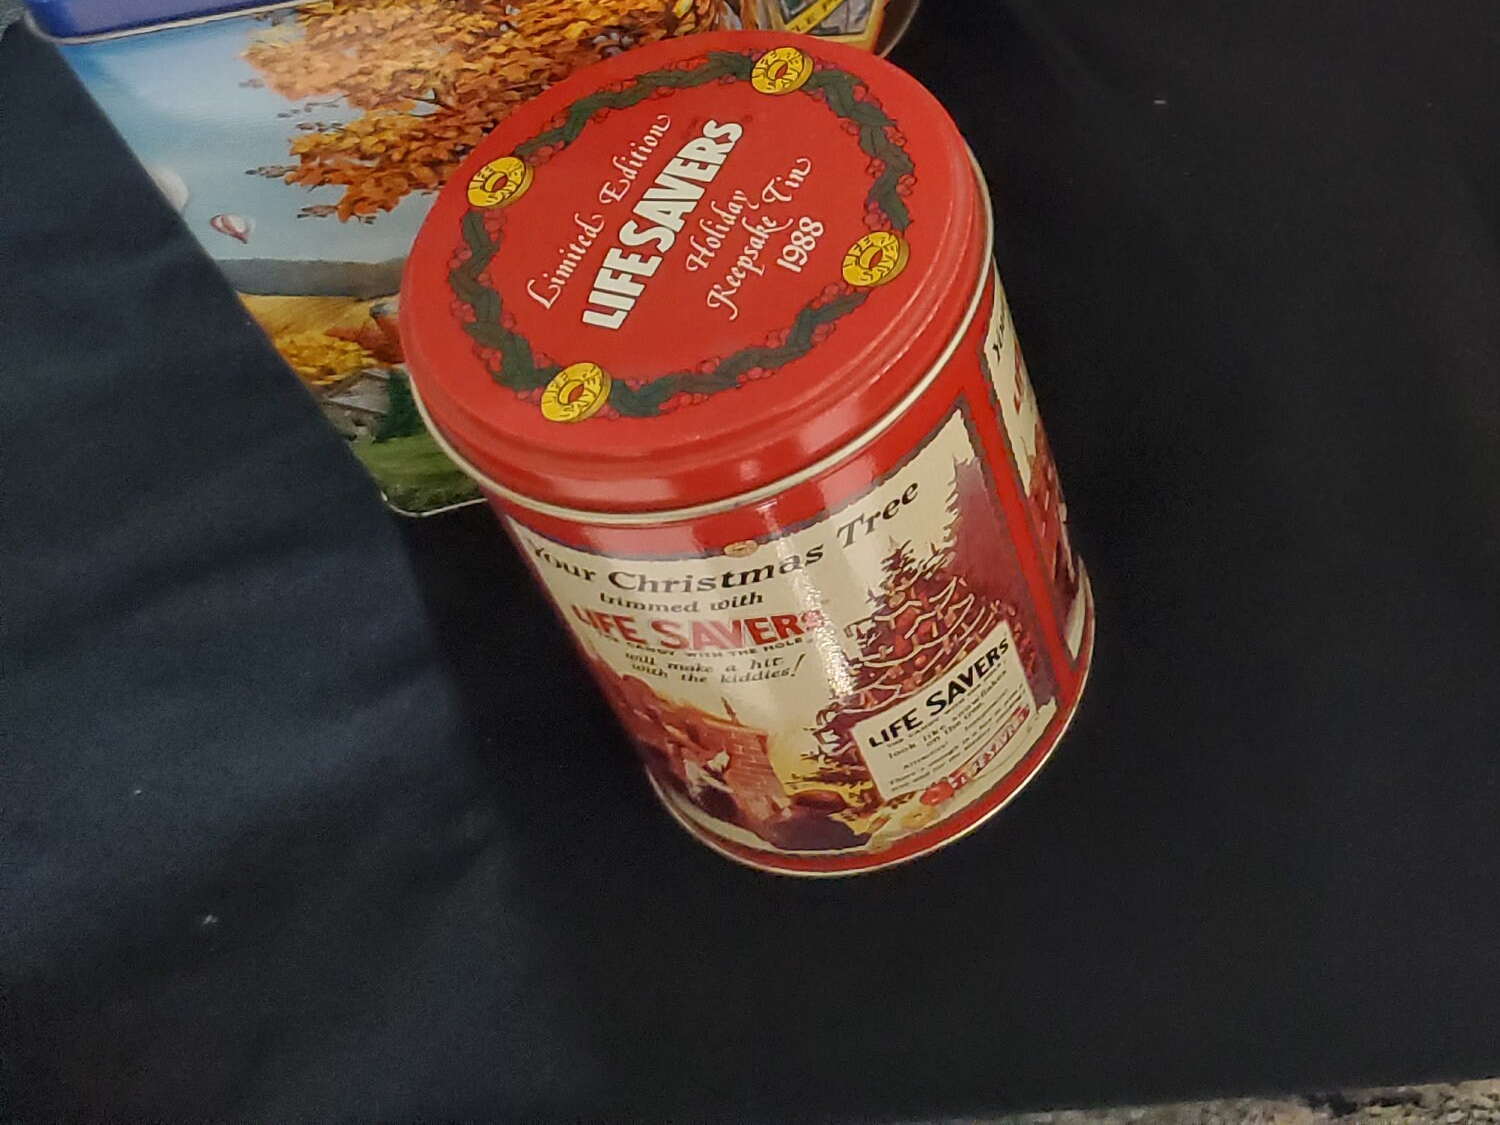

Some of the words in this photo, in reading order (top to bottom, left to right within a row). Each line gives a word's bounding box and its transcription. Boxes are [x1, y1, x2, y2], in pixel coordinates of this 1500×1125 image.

[526, 212, 605, 310] Limited
[599, 114, 672, 205] Edition
[685, 189, 760, 272] Holiday
[706, 215, 795, 322] Keepsake
[761, 157, 813, 205] Tin
[776, 215, 825, 274] 1988
[526, 537, 597, 582] Your
[607, 543, 825, 595] Christmas
[836, 482, 919, 550] Tree
[571, 604, 647, 646] LIFE
[650, 610, 823, 651] SAVERS
[599, 591, 700, 613] trimmed
[710, 591, 764, 612] with
[624, 650, 657, 667] will
[667, 662, 715, 674] make
[725, 665, 737, 673] a
[750, 657, 785, 672] hit
[631, 663, 670, 679] with
[680, 673, 709, 684] the
[720, 653, 807, 684] kiddies!
[868, 707, 924, 748] LIFE
[925, 637, 1010, 718] SAVERS
[888, 743, 917, 760] look
